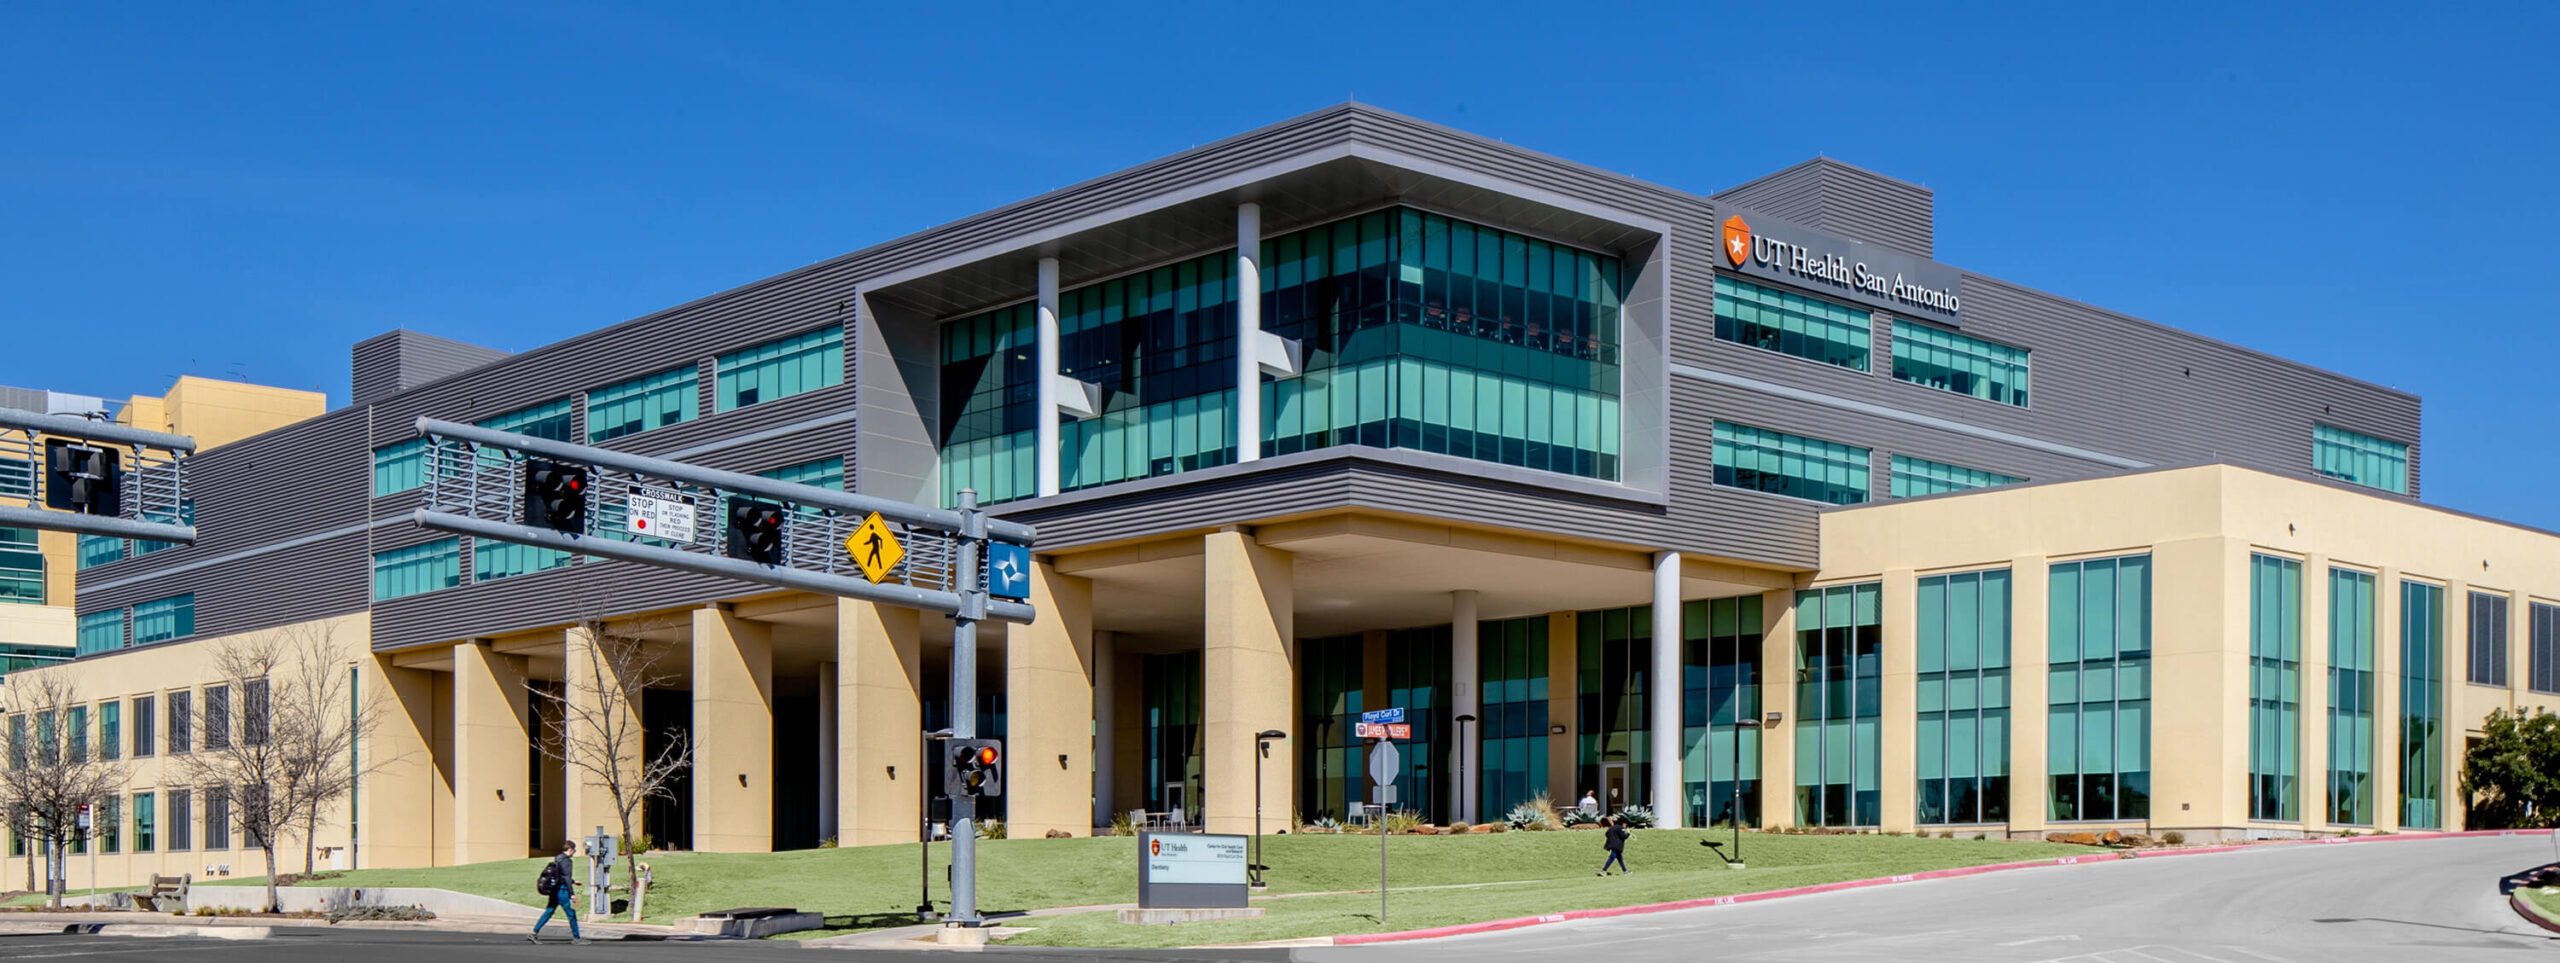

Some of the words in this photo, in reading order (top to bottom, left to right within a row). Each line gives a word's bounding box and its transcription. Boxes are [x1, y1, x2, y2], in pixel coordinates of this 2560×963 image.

[1752, 235, 1786, 267] UT
[1791, 248, 1851, 284] Health
[1854, 262, 1887, 294] San
[1891, 273, 1959, 312] Antonio
[641, 489, 684, 502] CROSSWALK
[631, 497, 654, 509] STOP
[669, 504, 683, 512] STOP
[629, 508, 639, 516] ON
[641, 510, 655, 519] RED
[1161, 843, 1170, 851] UT
[1171, 843, 1188, 852] Health
